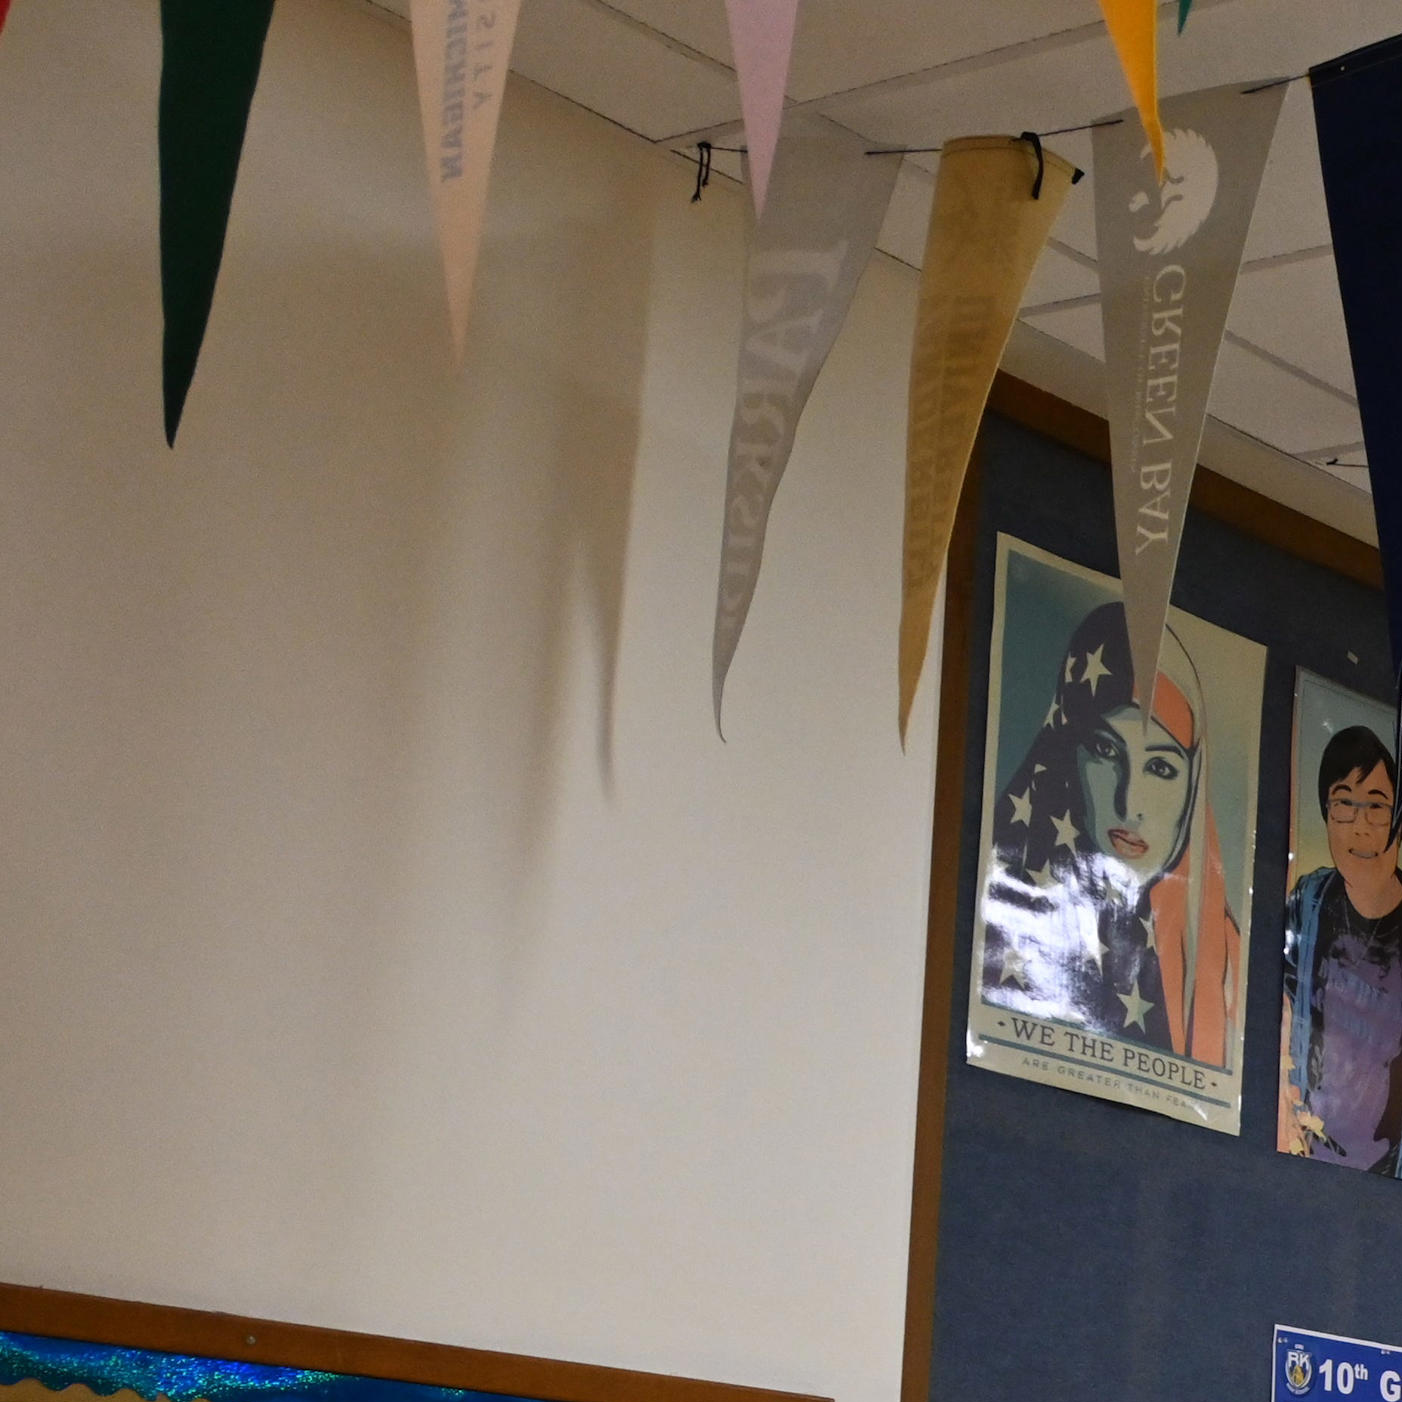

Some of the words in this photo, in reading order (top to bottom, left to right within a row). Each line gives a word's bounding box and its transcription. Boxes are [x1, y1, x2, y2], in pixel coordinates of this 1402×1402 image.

[1010, 1016, 1057, 1047] WE
[1063, 1031, 1115, 1063] THE
[1121, 1047, 1207, 1091] PEOPLE
[1021, 1056, 1049, 1072] ARE
[1318, 1359, 1368, 1395] 10th
